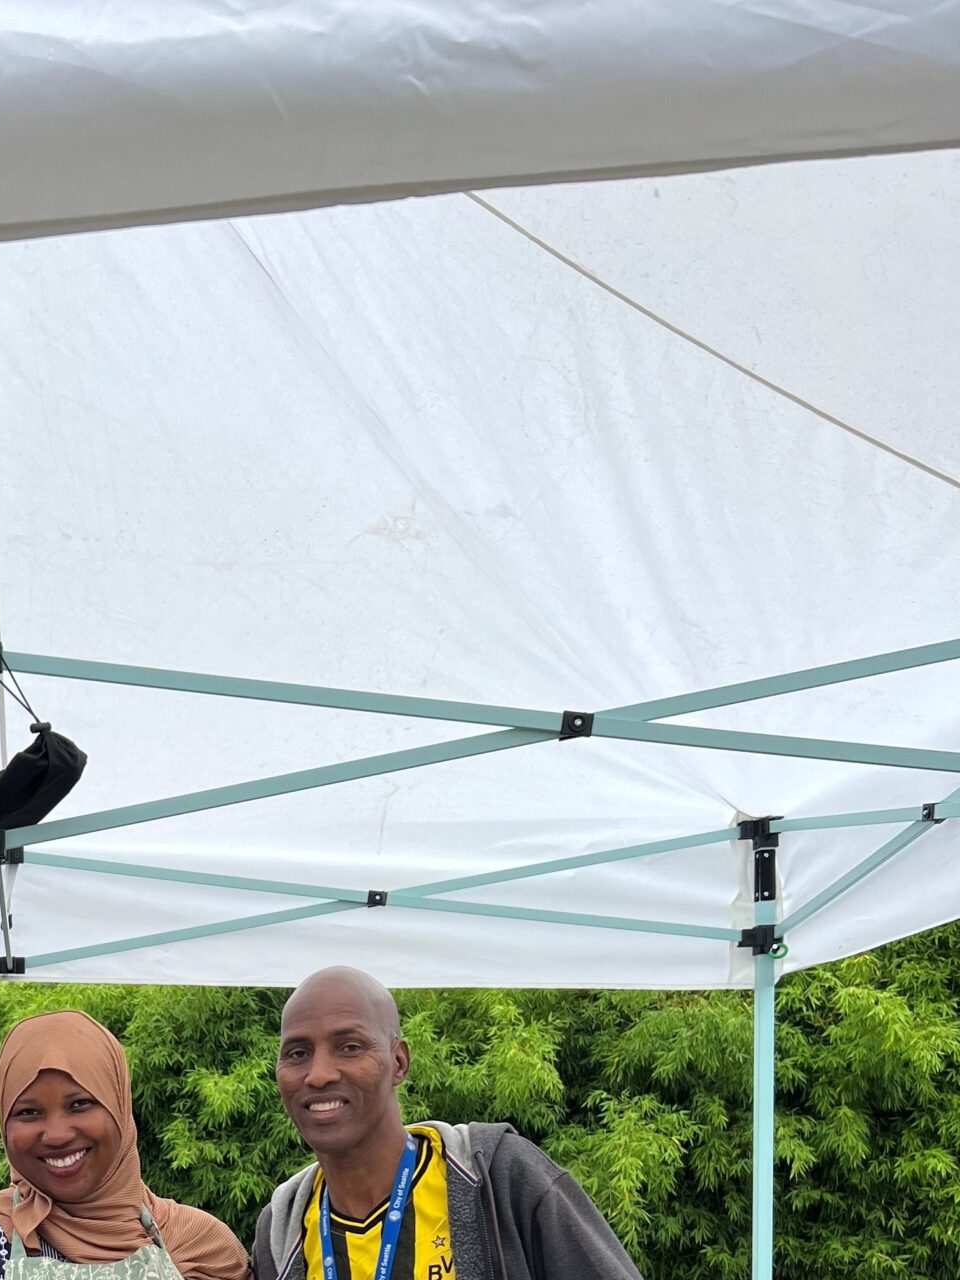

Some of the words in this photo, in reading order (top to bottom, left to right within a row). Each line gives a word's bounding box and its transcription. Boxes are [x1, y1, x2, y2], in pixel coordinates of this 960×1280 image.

[398, 1167, 410, 1189] Seattle
[393, 1194, 404, 1209] City
[381, 1243, 392, 1267] Seattle
